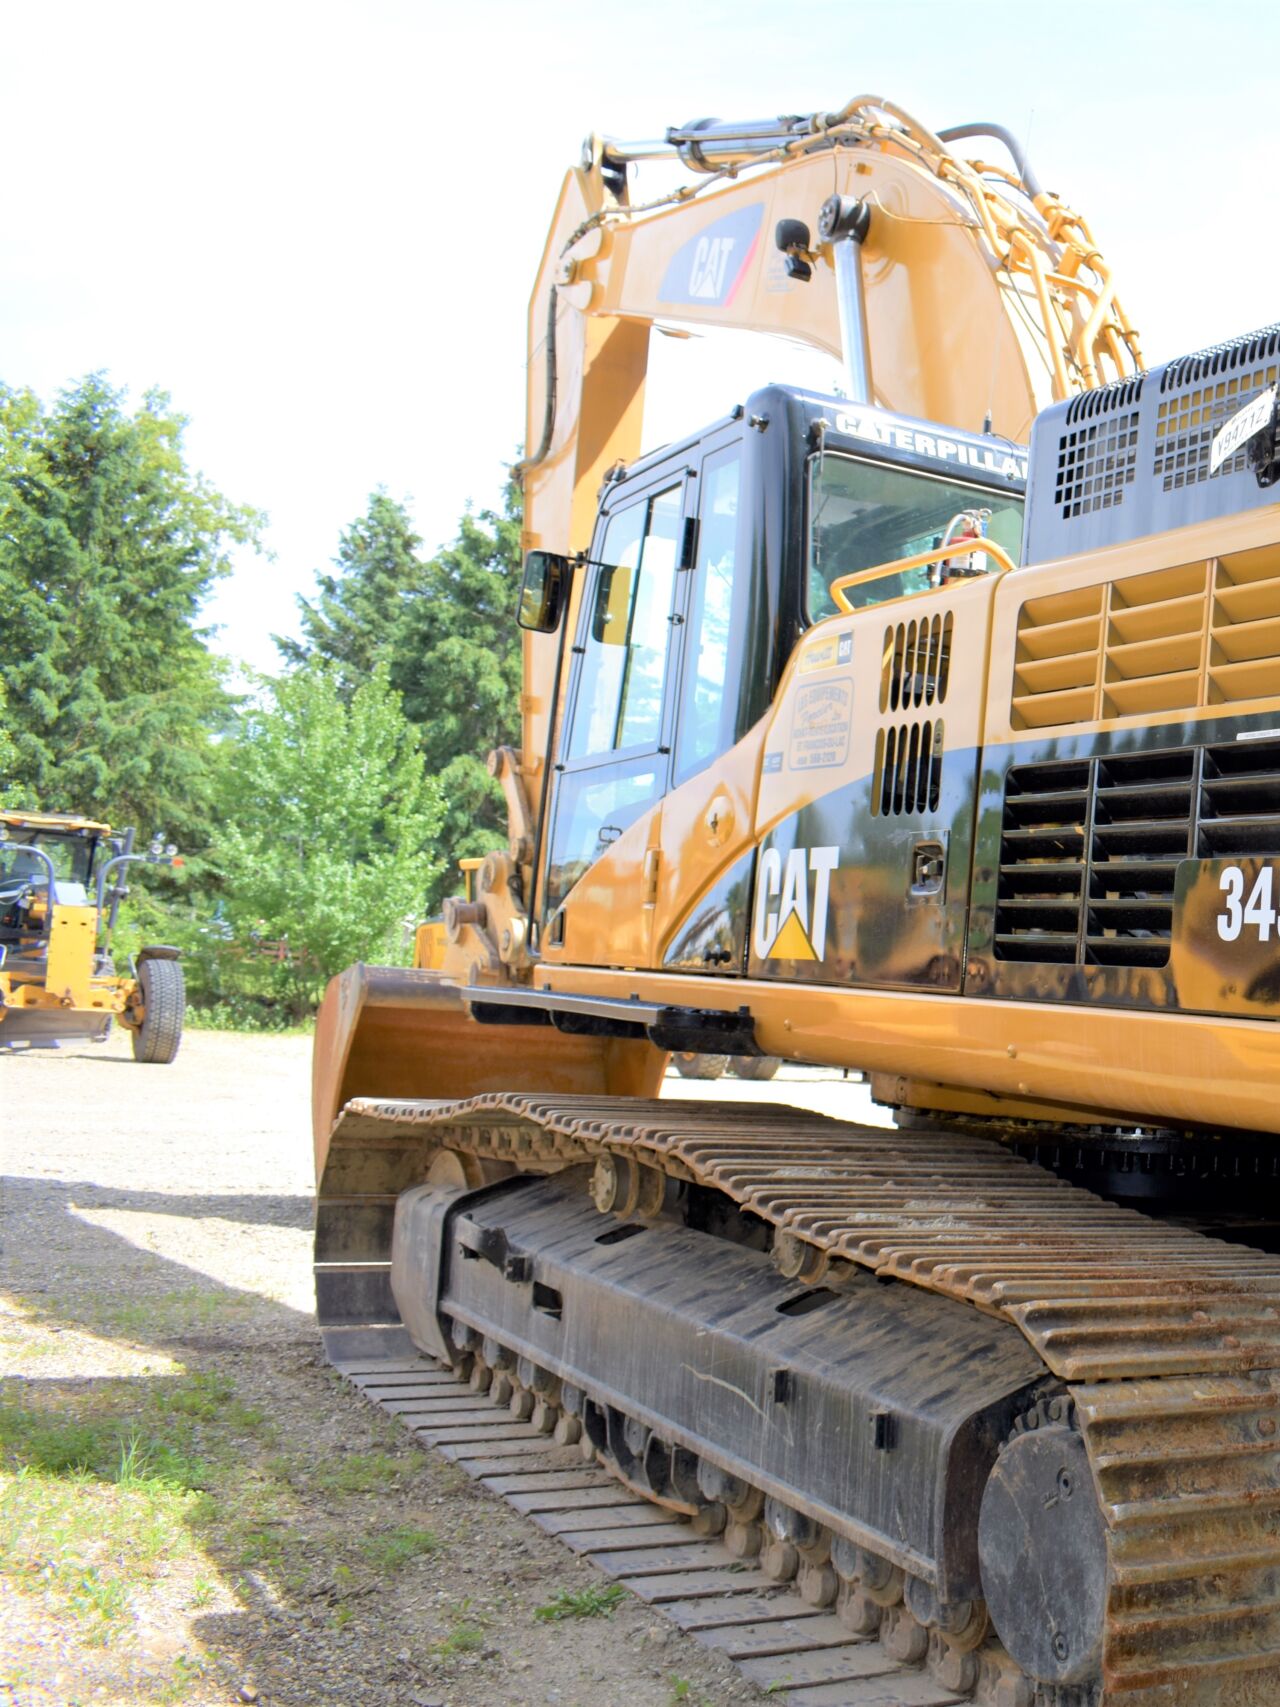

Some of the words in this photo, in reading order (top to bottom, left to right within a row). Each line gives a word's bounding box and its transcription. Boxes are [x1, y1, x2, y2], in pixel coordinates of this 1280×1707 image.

[688, 236, 735, 299] CAT
[836, 415, 1029, 480] CATERPILLA
[838, 639, 852, 656] CAT
[754, 846, 840, 963] CAT
